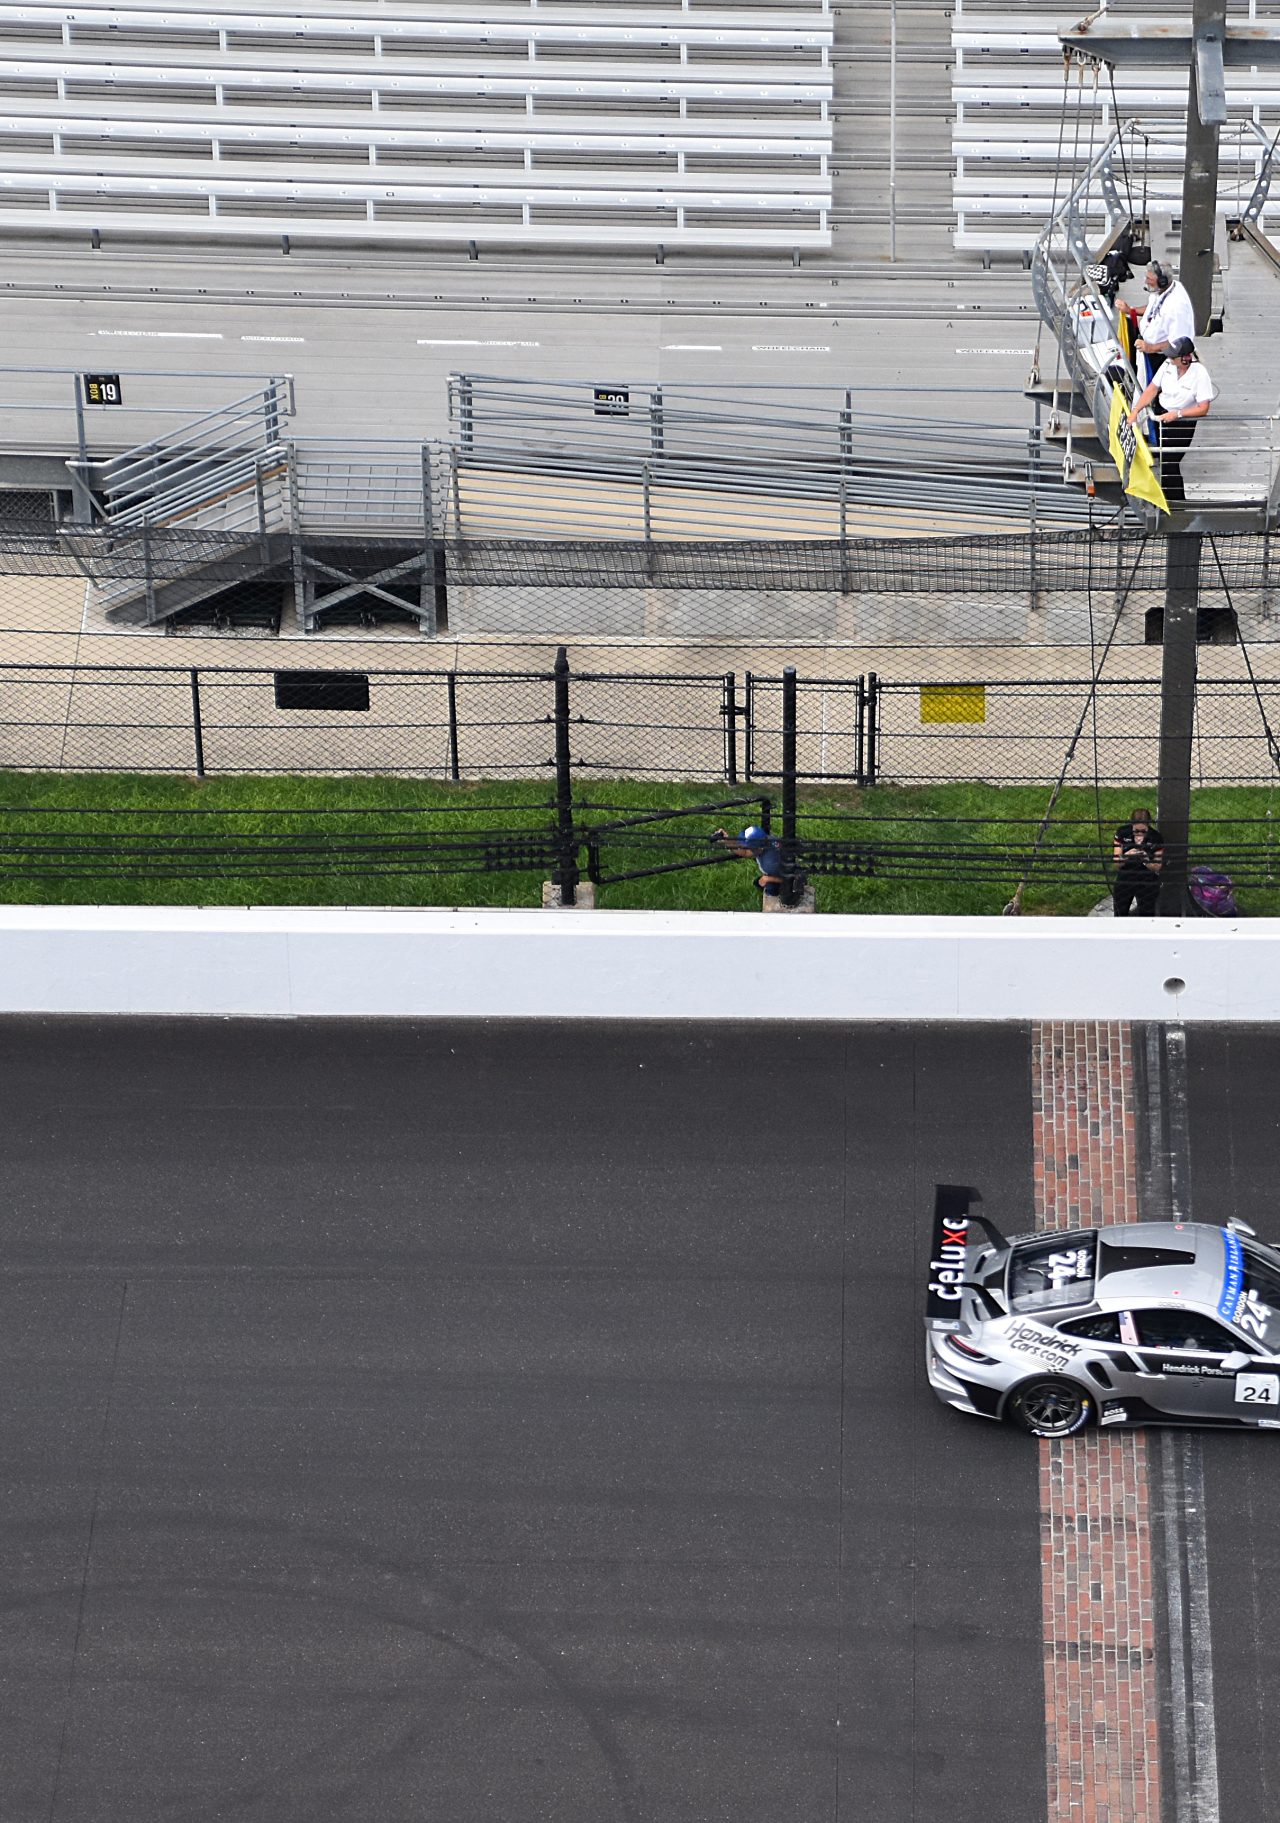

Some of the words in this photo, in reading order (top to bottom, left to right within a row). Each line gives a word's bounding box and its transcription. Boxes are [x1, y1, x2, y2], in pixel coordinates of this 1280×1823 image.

[89, 383, 99, 400] BOX
[100, 383, 117, 401] 19
[1048, 1250, 1077, 1280] 24
[1221, 1271, 1239, 1315] CAYMAN
[1232, 1290, 1248, 1323] GORDON
[1240, 1298, 1272, 1340] 24
[1003, 1319, 1083, 1357] Hendrick
[1010, 1339, 1069, 1368] Cars.com
[1162, 1363, 1200, 1374] Hendrick
[1243, 1387, 1271, 1402] 24
